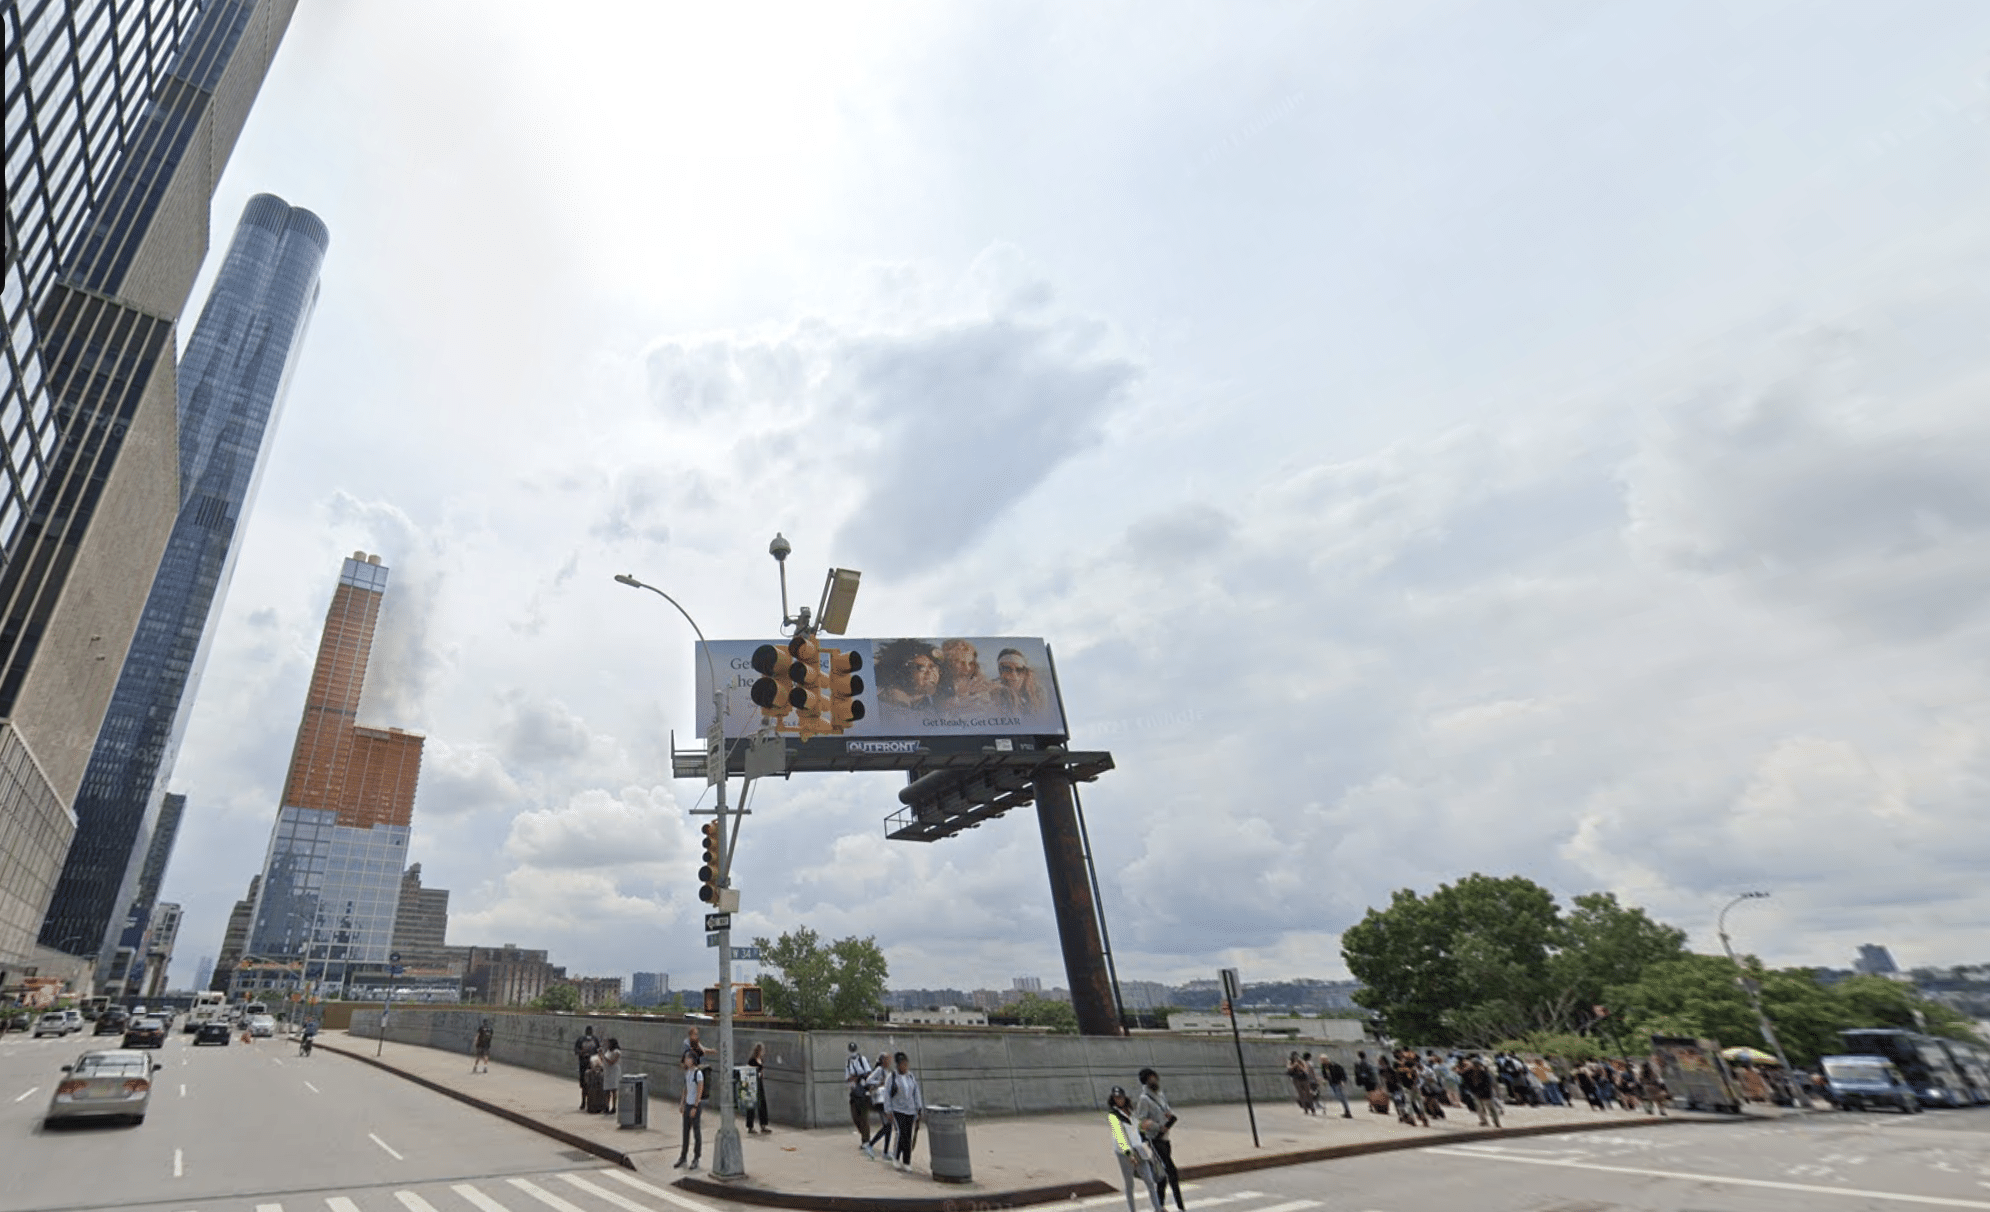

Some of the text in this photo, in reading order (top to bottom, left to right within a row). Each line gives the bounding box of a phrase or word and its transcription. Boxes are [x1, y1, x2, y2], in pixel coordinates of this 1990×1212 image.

[730, 657, 754, 670] Ge
[922, 717, 1021, 729] Get Ready, Get CLEAR
[849, 741, 917, 753] OUTFRONT
